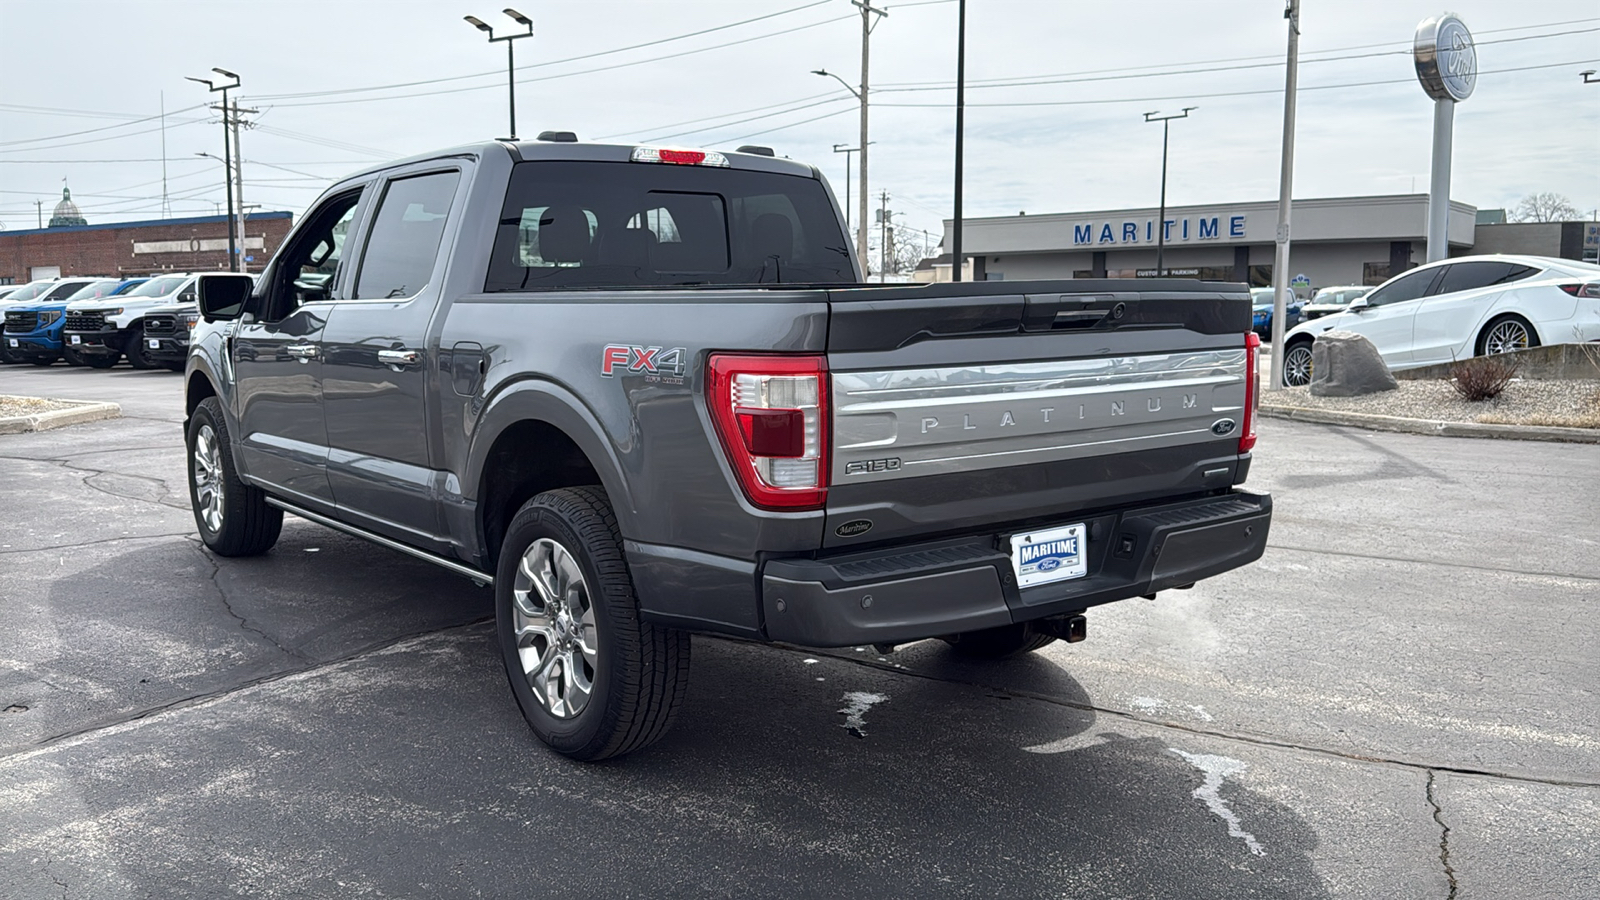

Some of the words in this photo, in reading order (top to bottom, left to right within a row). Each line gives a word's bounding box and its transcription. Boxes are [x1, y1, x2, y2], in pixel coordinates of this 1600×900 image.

[1073, 215, 1246, 245] MARITIME
[1171, 268, 1199, 276] PARKING
[601, 343, 686, 378] FX4
[921, 393, 1198, 434] PLATINUM
[845, 457, 901, 475] F-150
[839, 522, 870, 535] Maritime
[1021, 538, 1077, 564] MARITIME
[1040, 560, 1057, 571] Ford
